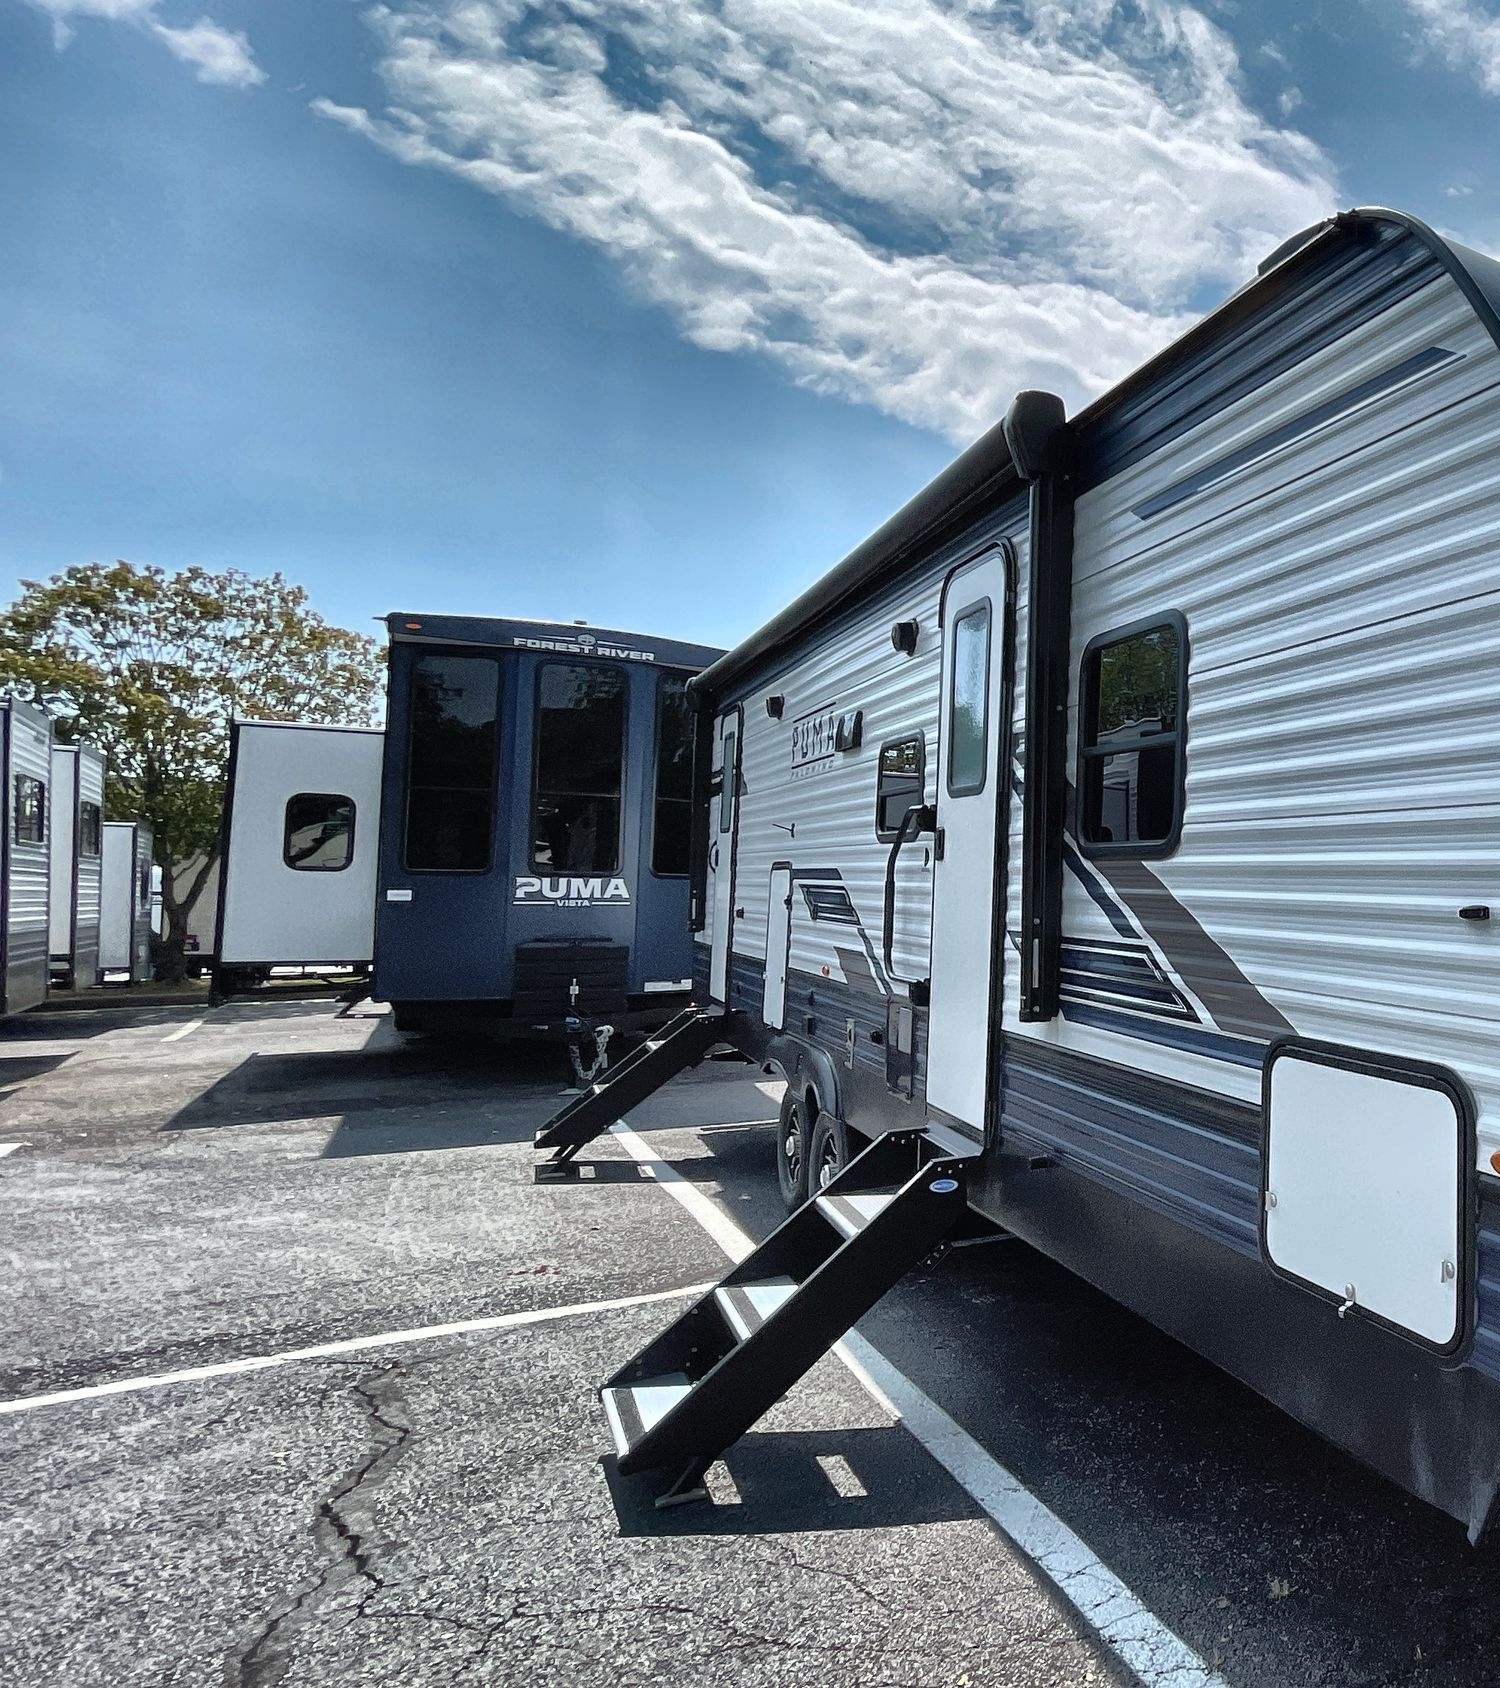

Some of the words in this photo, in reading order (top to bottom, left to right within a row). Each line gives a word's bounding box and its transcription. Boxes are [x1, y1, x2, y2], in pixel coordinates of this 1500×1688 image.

[513, 637, 594, 654] FOREST
[597, 646, 655, 661] RIVER
[792, 711, 835, 764] PUMA
[514, 877, 630, 899] PUMA
[556, 899, 591, 907] VISTA
